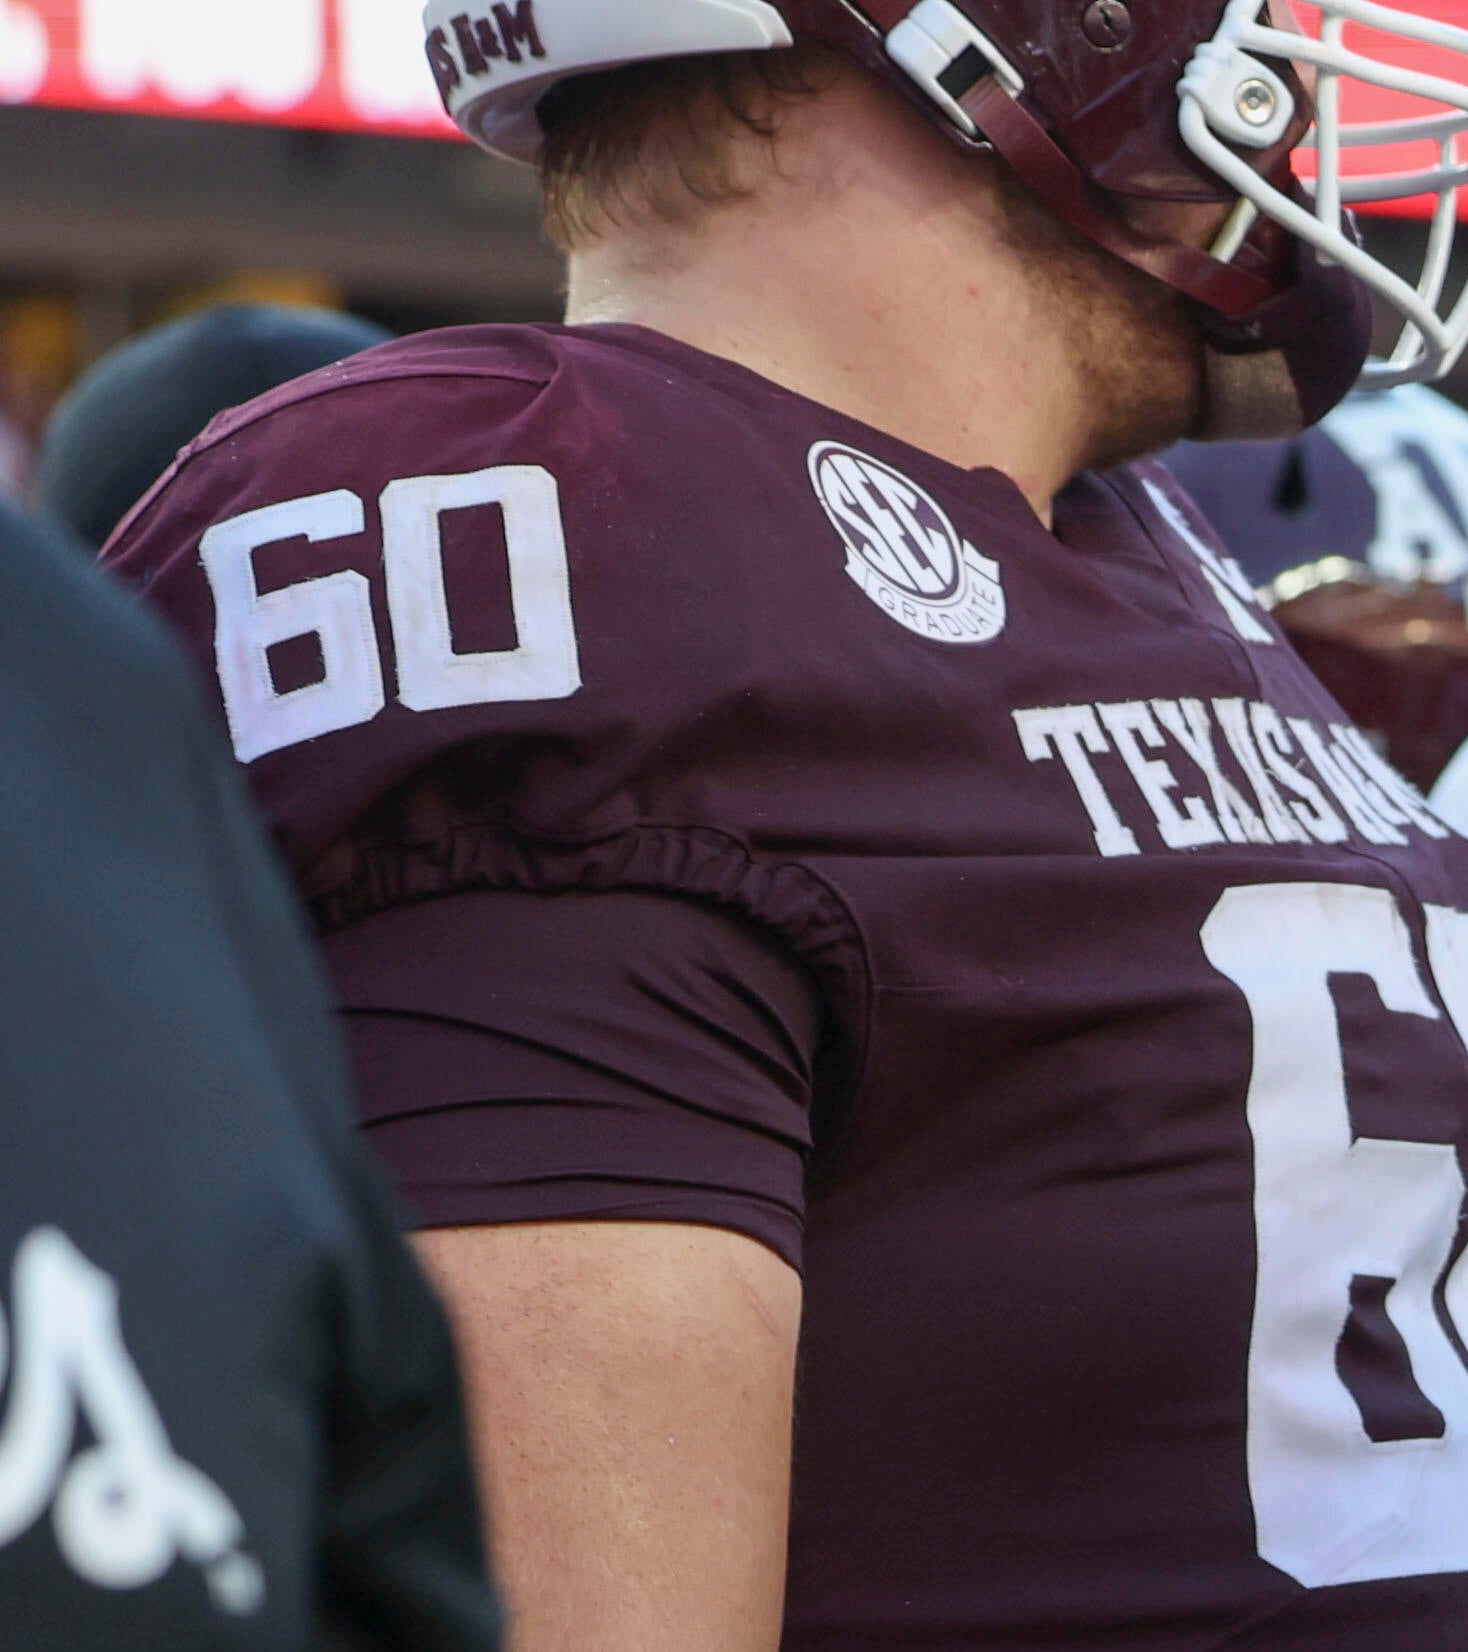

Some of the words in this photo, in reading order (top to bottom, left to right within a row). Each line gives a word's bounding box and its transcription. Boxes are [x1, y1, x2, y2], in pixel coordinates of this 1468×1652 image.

[819, 453, 955, 595] SEC
[198, 465, 584, 765] 60
[877, 581, 997, 637] GRADUATE
[1011, 696, 1350, 858] TEXAS
